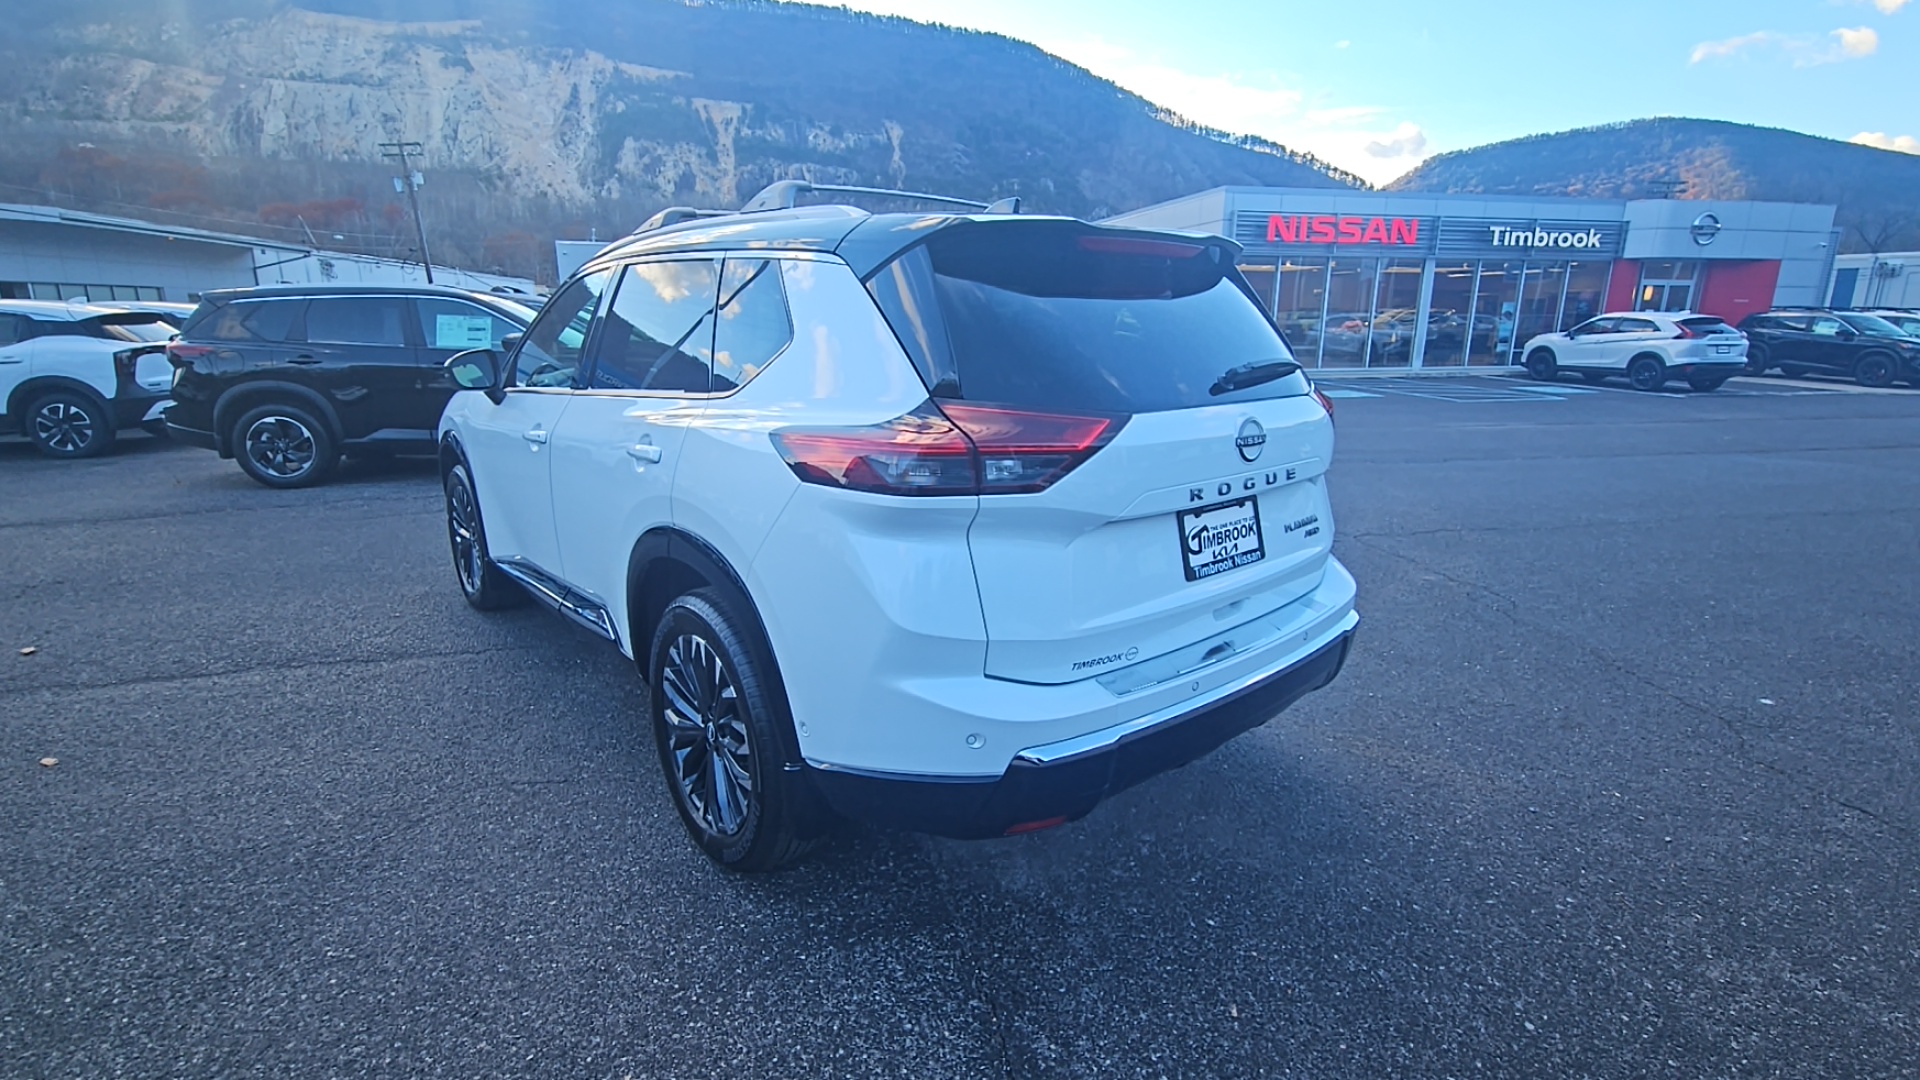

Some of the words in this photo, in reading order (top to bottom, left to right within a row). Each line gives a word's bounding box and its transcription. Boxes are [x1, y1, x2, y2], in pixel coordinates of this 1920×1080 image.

[1267, 215, 1419, 245] NISSAN
[1489, 226, 1602, 248] Timbrook
[1189, 468, 1297, 502] ROGUE
[1188, 522, 1256, 554] TIMBROOK
[1193, 557, 1234, 579] Timbrook
[1234, 551, 1261, 567] Nissan
[1071, 652, 1125, 671] TIMBROOK
